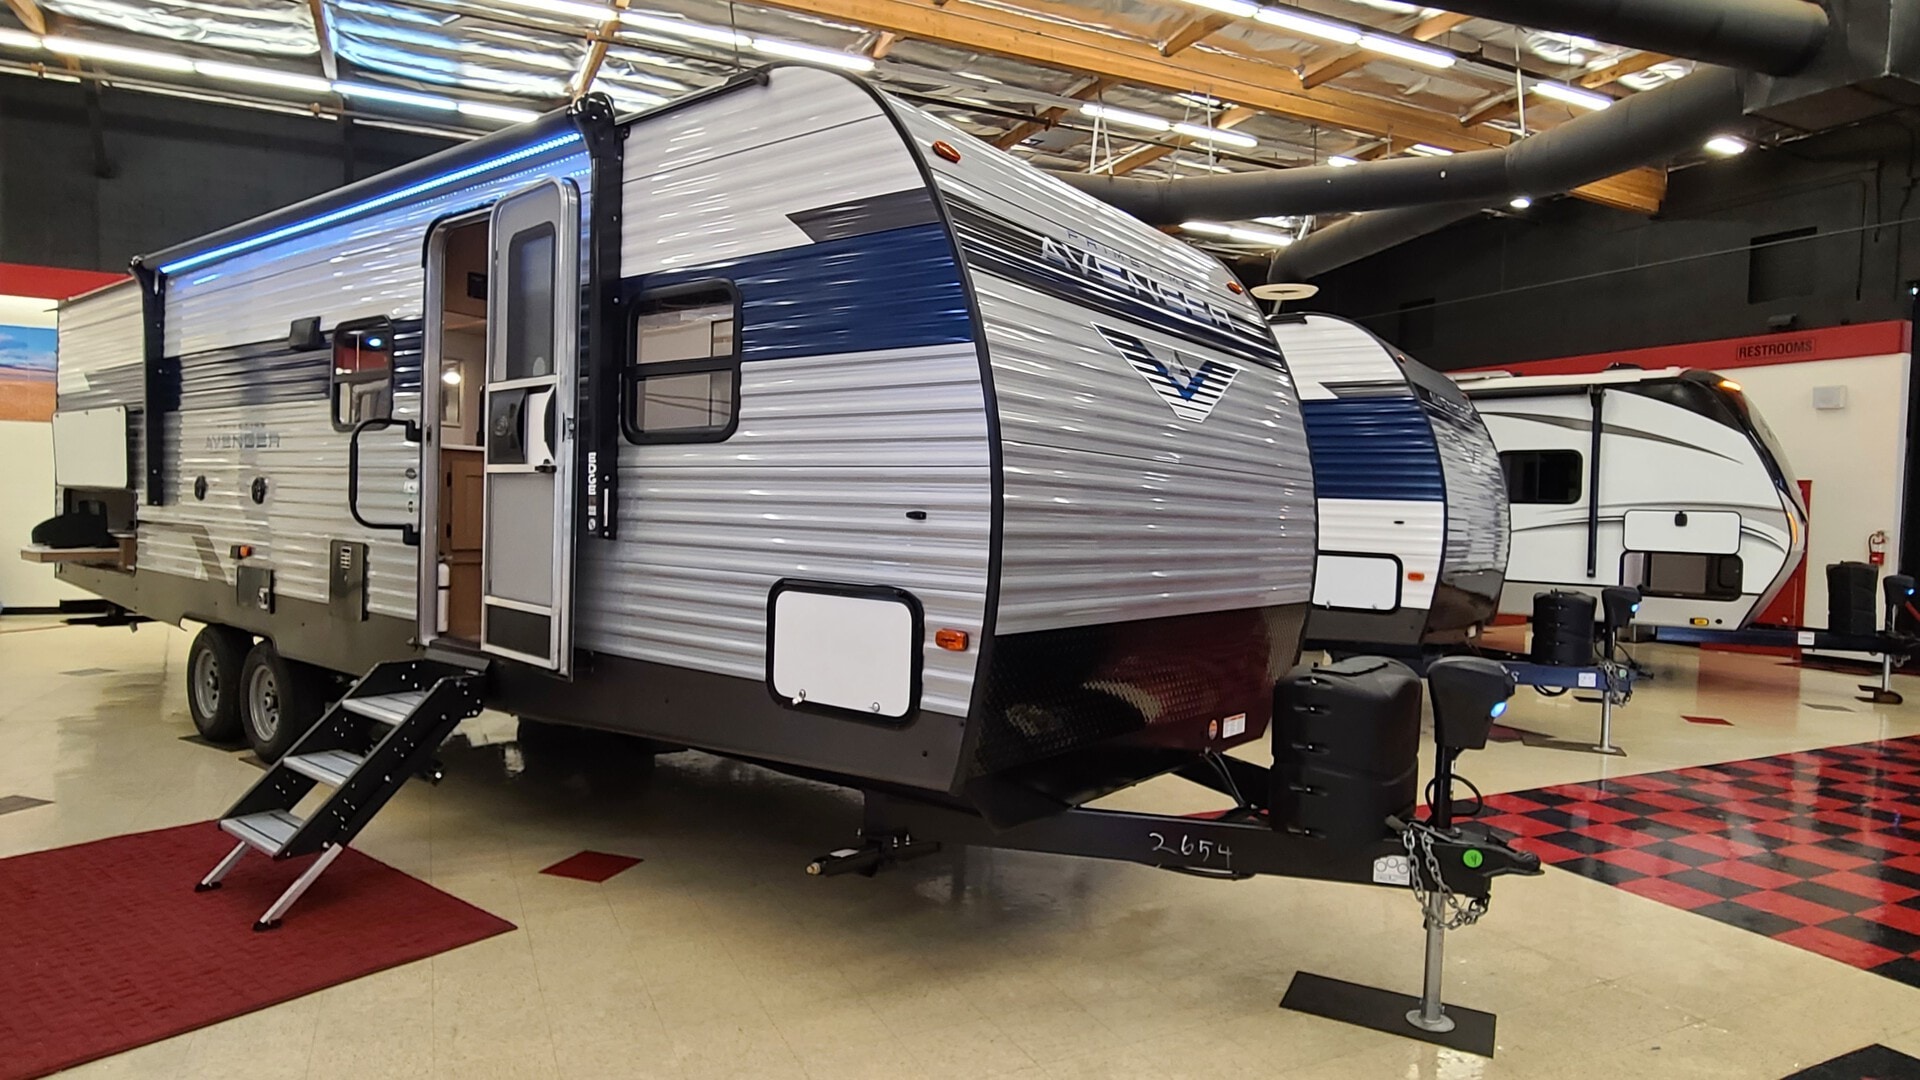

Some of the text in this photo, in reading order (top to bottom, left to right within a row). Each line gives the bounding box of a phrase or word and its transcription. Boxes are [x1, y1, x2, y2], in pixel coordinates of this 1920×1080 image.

[1040, 236, 1235, 331] AVENGER
[1739, 340, 1812, 359] RESTROOMS
[206, 433, 280, 449] AVENGER
[1149, 832, 1233, 869] 2654
